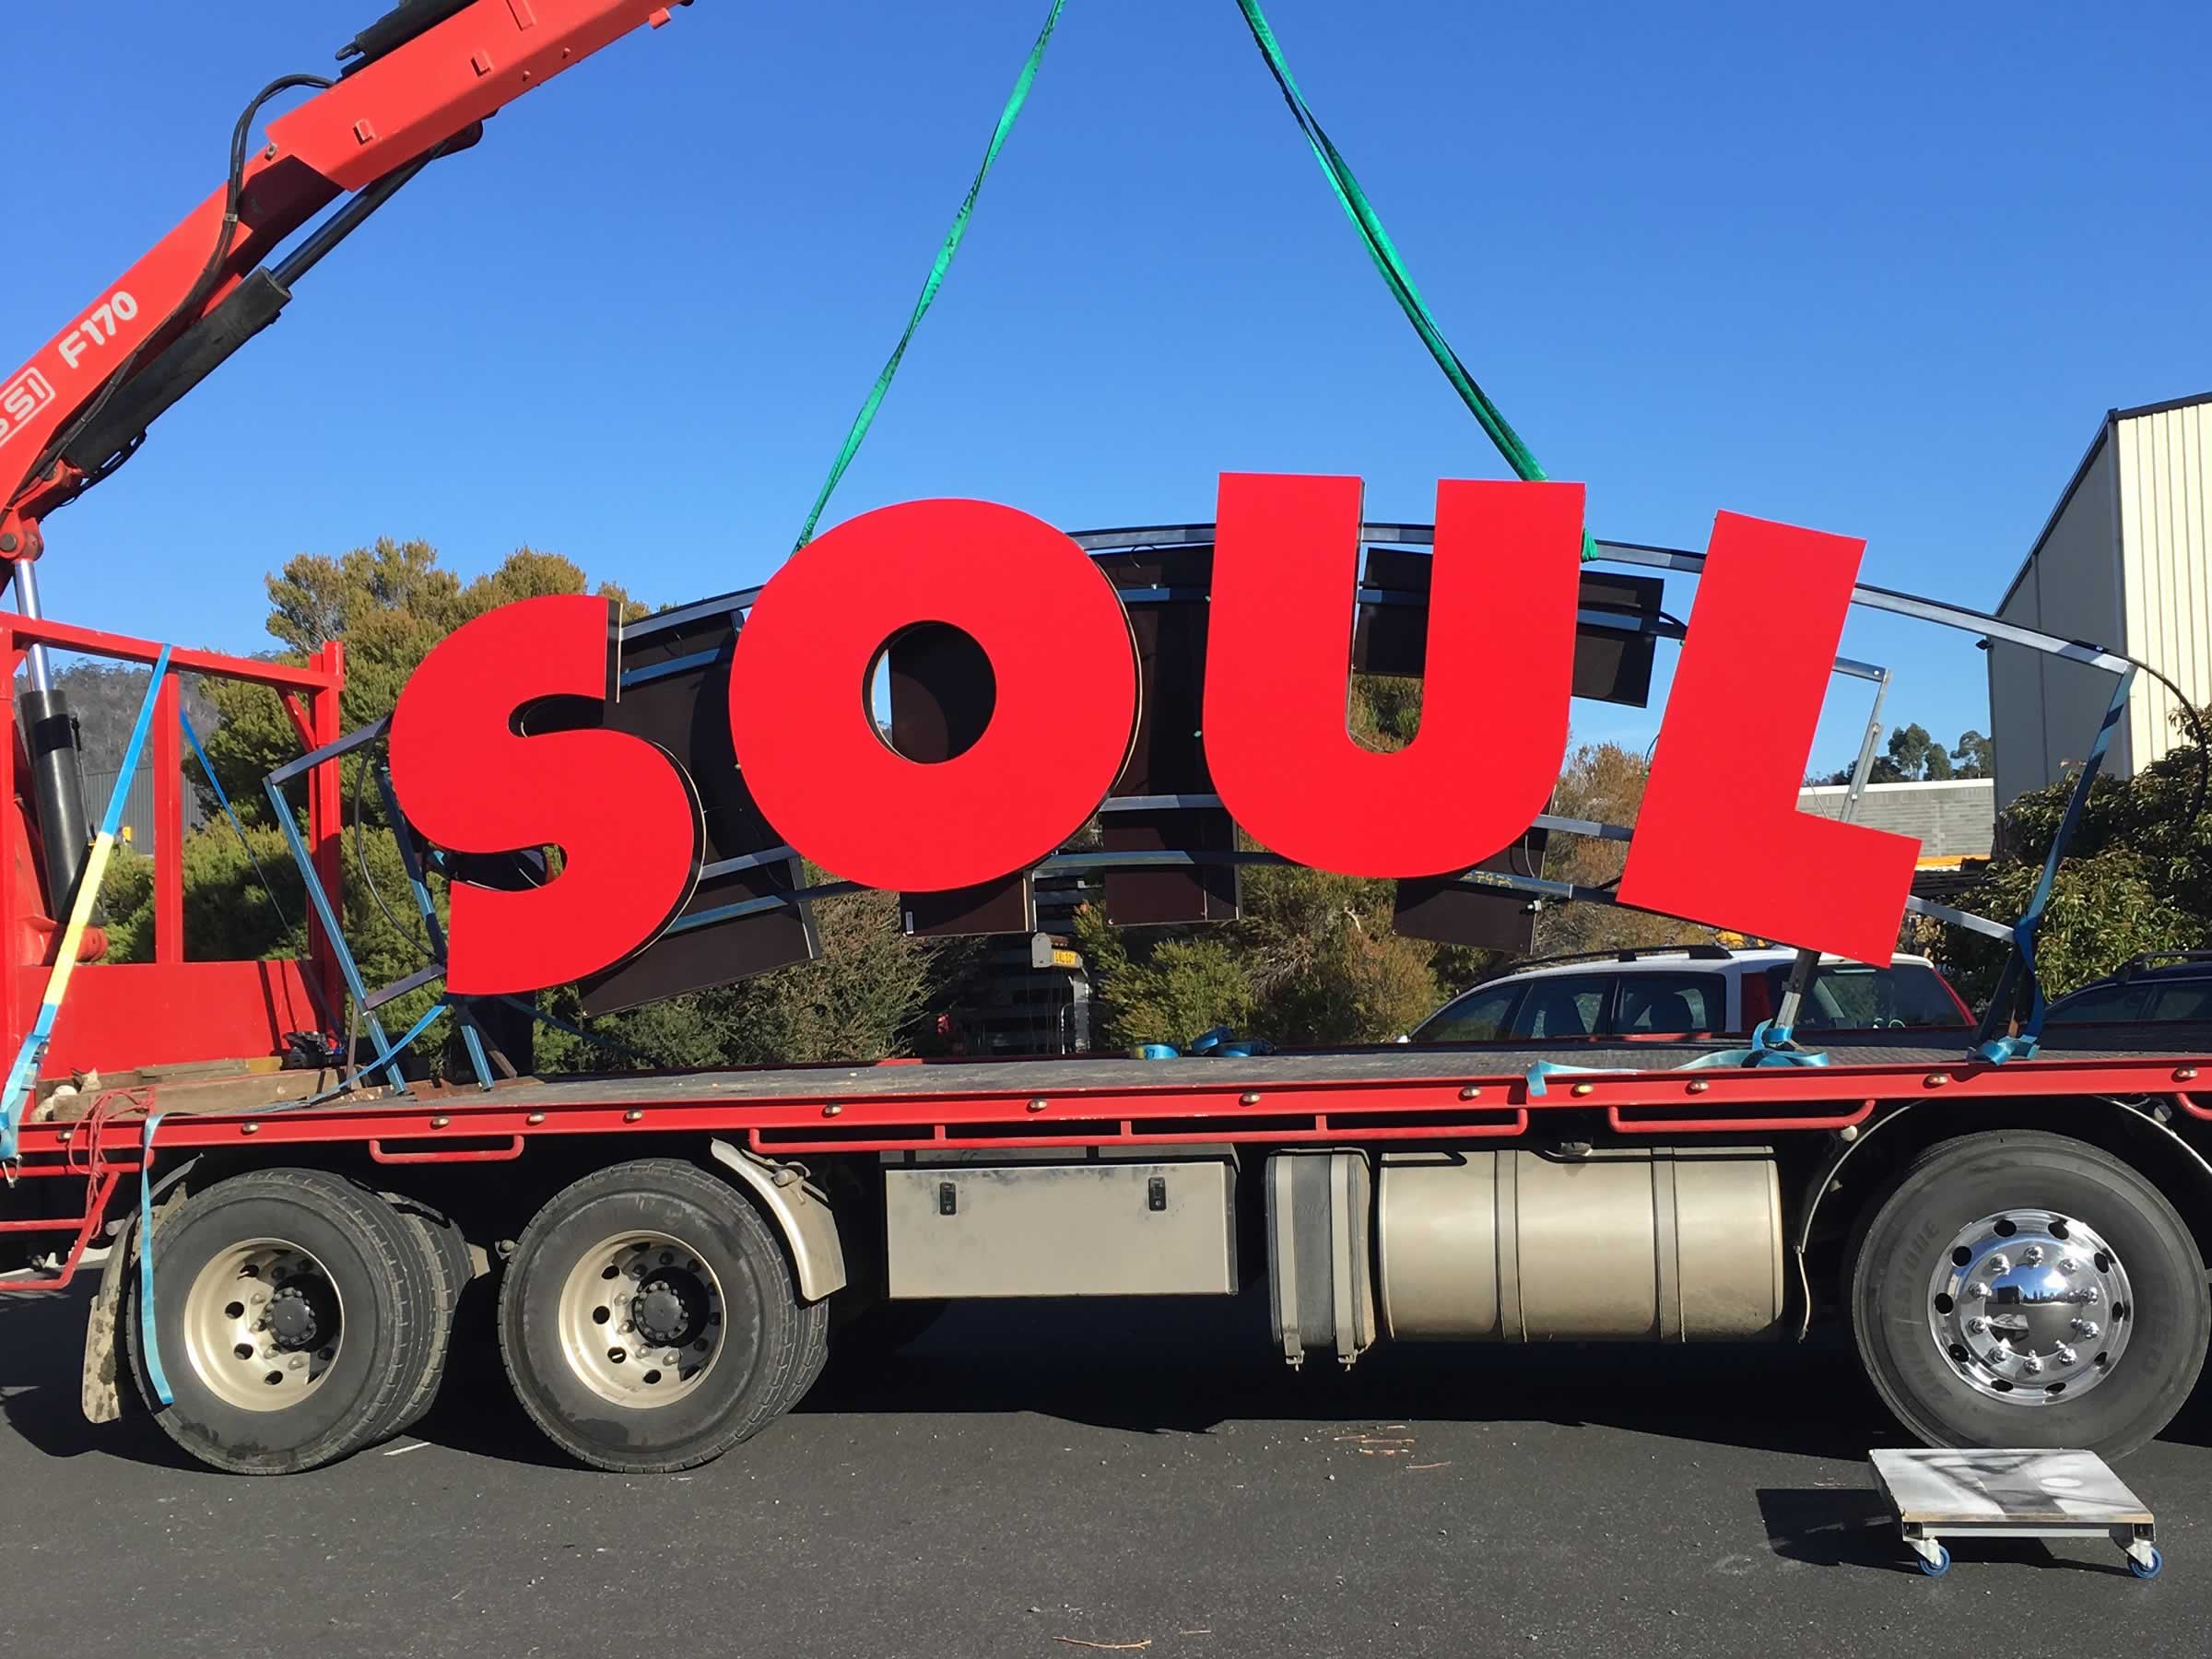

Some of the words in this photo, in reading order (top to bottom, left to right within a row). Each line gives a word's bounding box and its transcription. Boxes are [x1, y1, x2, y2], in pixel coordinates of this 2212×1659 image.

[0, 377, 45, 437] SI
[58, 291, 138, 369] F170
[389, 473, 1921, 996] SOUL
